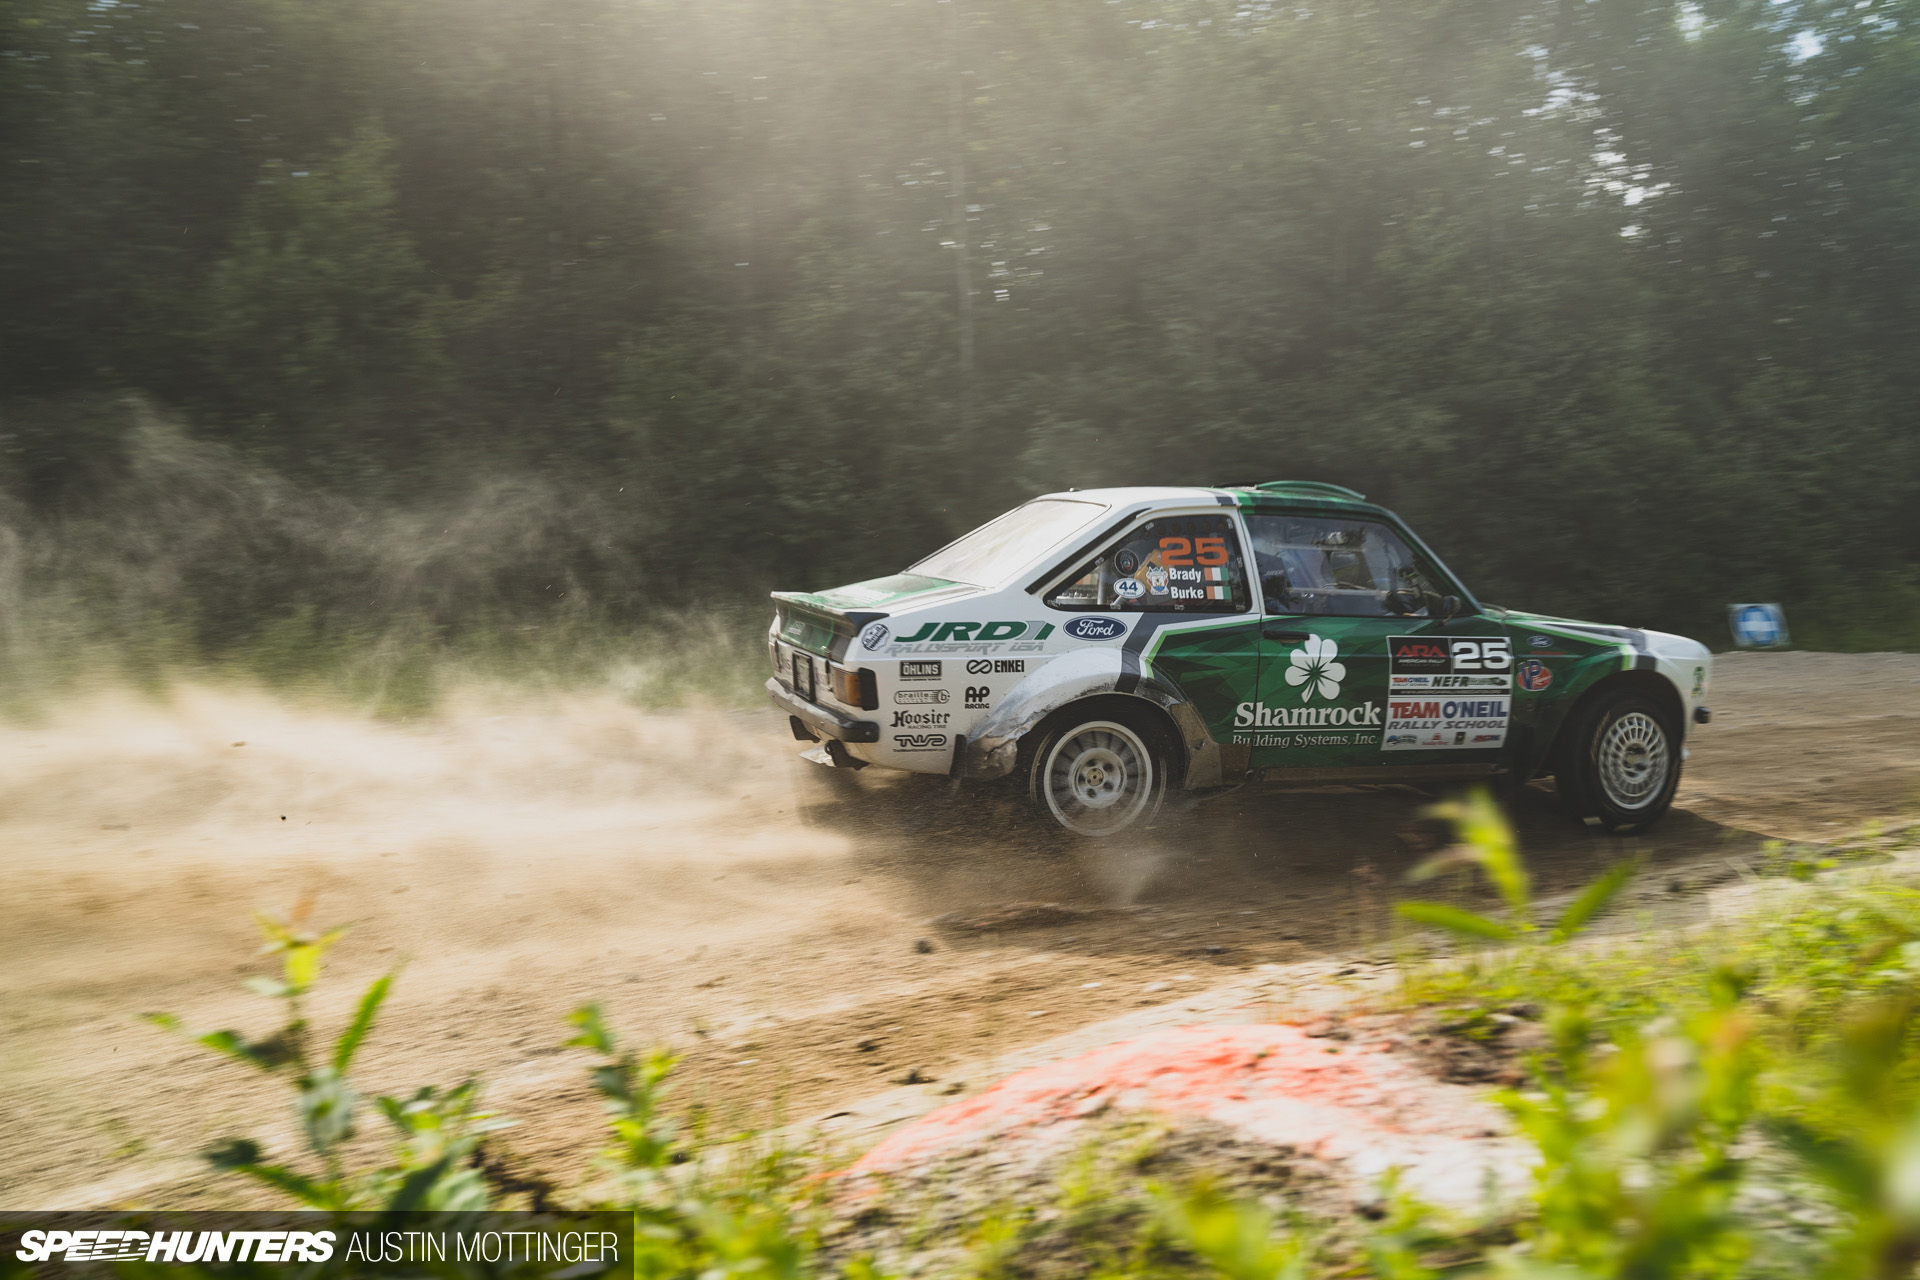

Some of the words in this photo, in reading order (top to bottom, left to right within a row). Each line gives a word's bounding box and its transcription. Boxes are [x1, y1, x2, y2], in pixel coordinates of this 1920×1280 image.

[1158, 537, 1229, 566] 25
[1168, 567, 1202, 583] Brady
[1118, 581, 1139, 592] 44
[1170, 585, 1204, 600] Burke
[1076, 618, 1115, 637] Ford
[1396, 644, 1448, 658] ARA
[1452, 641, 1512, 669] 25
[903, 662, 940, 676] ÖHLINS
[994, 659, 1025, 673] ENKEI
[1431, 676, 1469, 688] NEFR
[897, 691, 930, 699] braille
[964, 686, 991, 703] AP
[1233, 701, 1382, 727] Shamrock
[1389, 701, 1440, 719] TEAM
[1442, 700, 1508, 719] O'NEIL
[889, 708, 951, 728] Hoosier
[1387, 720, 1442, 730] RALLY
[1443, 720, 1508, 730] SCHOOL
[1232, 734, 1291, 748] Building
[1353, 733, 1378, 745] Inc.
